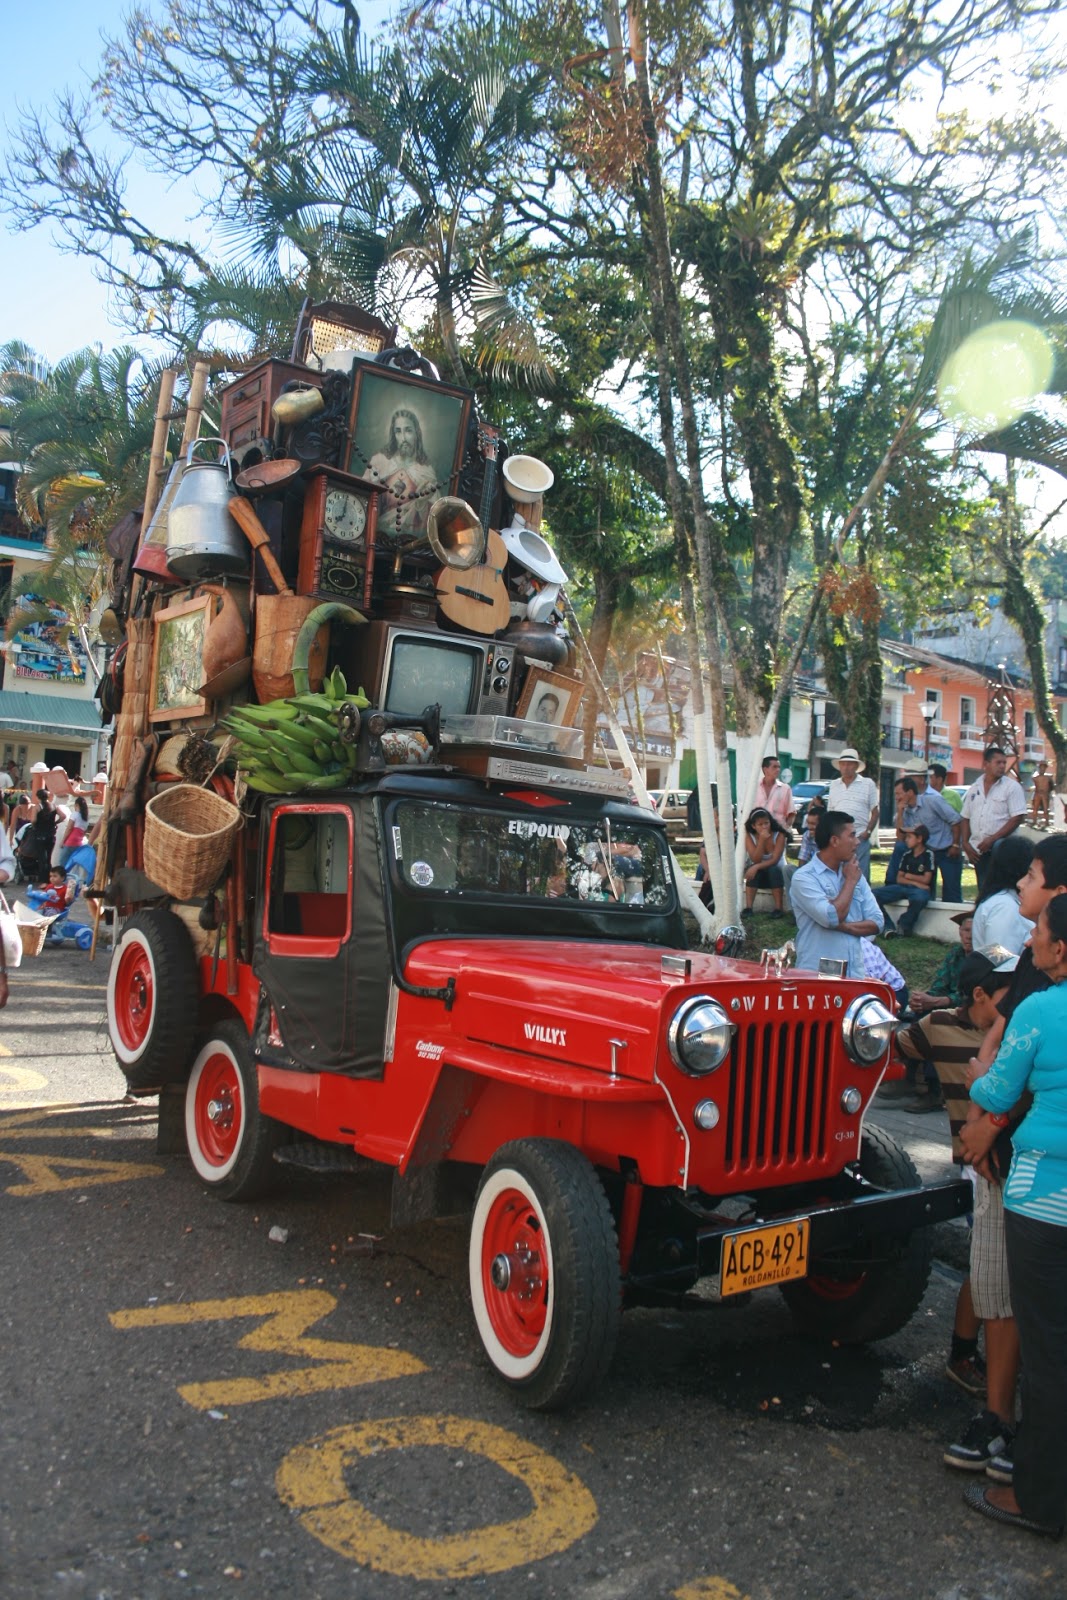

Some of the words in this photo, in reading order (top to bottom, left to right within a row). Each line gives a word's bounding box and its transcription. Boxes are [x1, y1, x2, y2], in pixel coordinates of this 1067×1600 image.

[508, 820, 524, 835] EL
[527, 821, 571, 840] POLLO
[743, 995, 831, 1012] WILLYS
[524, 1023, 567, 1047] WILLYS
[742, 1266, 791, 1286] ROLDANILLO
